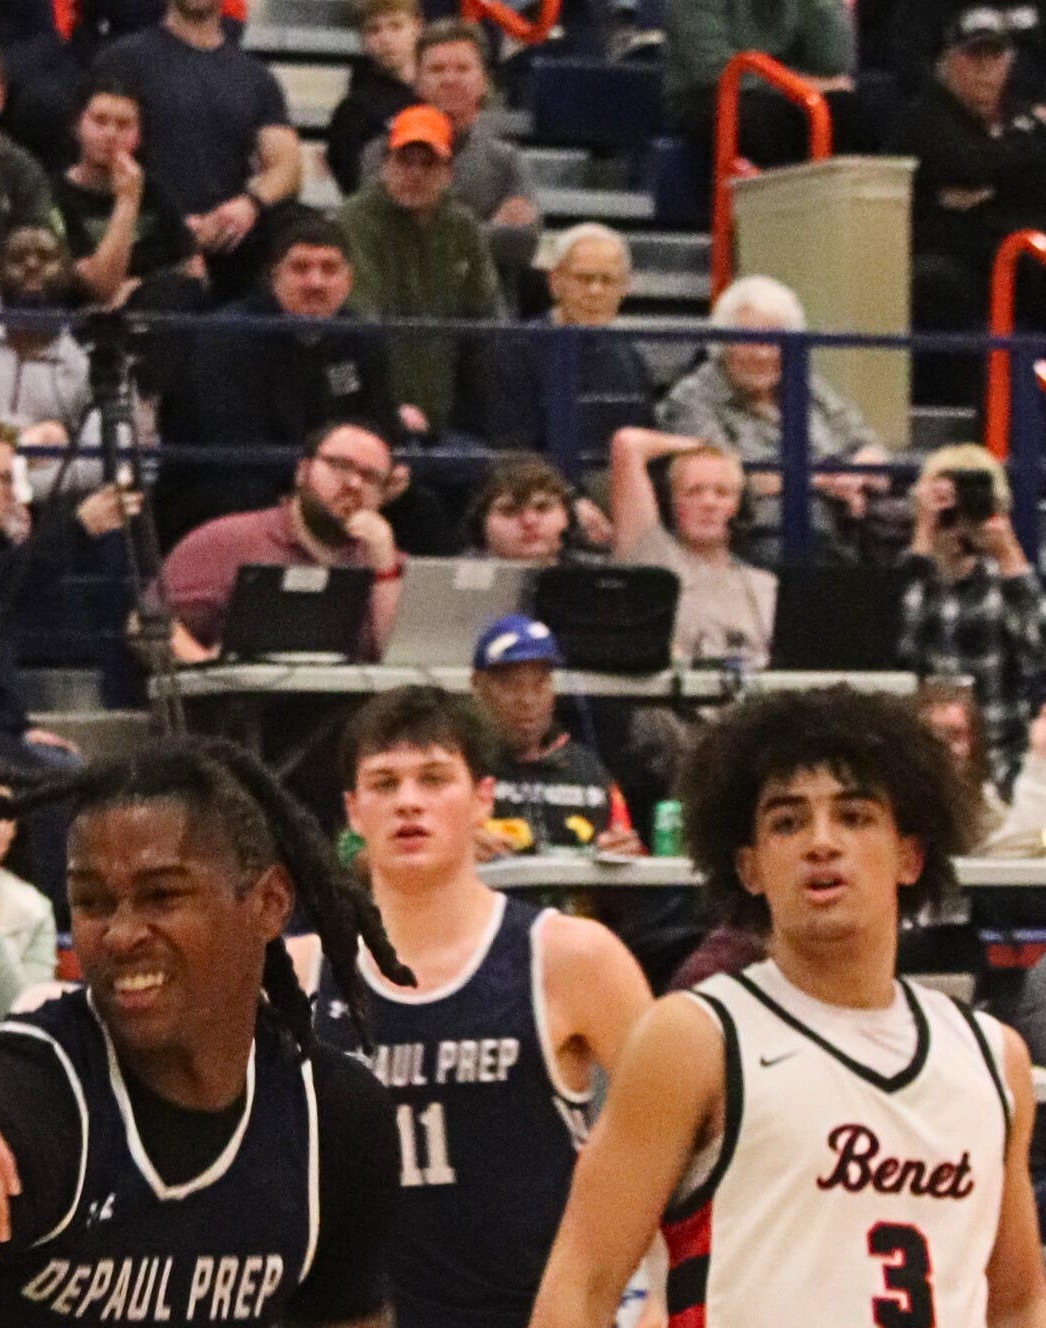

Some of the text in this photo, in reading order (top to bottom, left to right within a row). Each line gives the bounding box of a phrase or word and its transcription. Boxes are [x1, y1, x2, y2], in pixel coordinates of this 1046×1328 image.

[435, 1036, 521, 1084] PREP
[395, 1101, 457, 1188] 11
[815, 1122, 976, 1200] Benet
[185, 1252, 285, 1322] PREP
